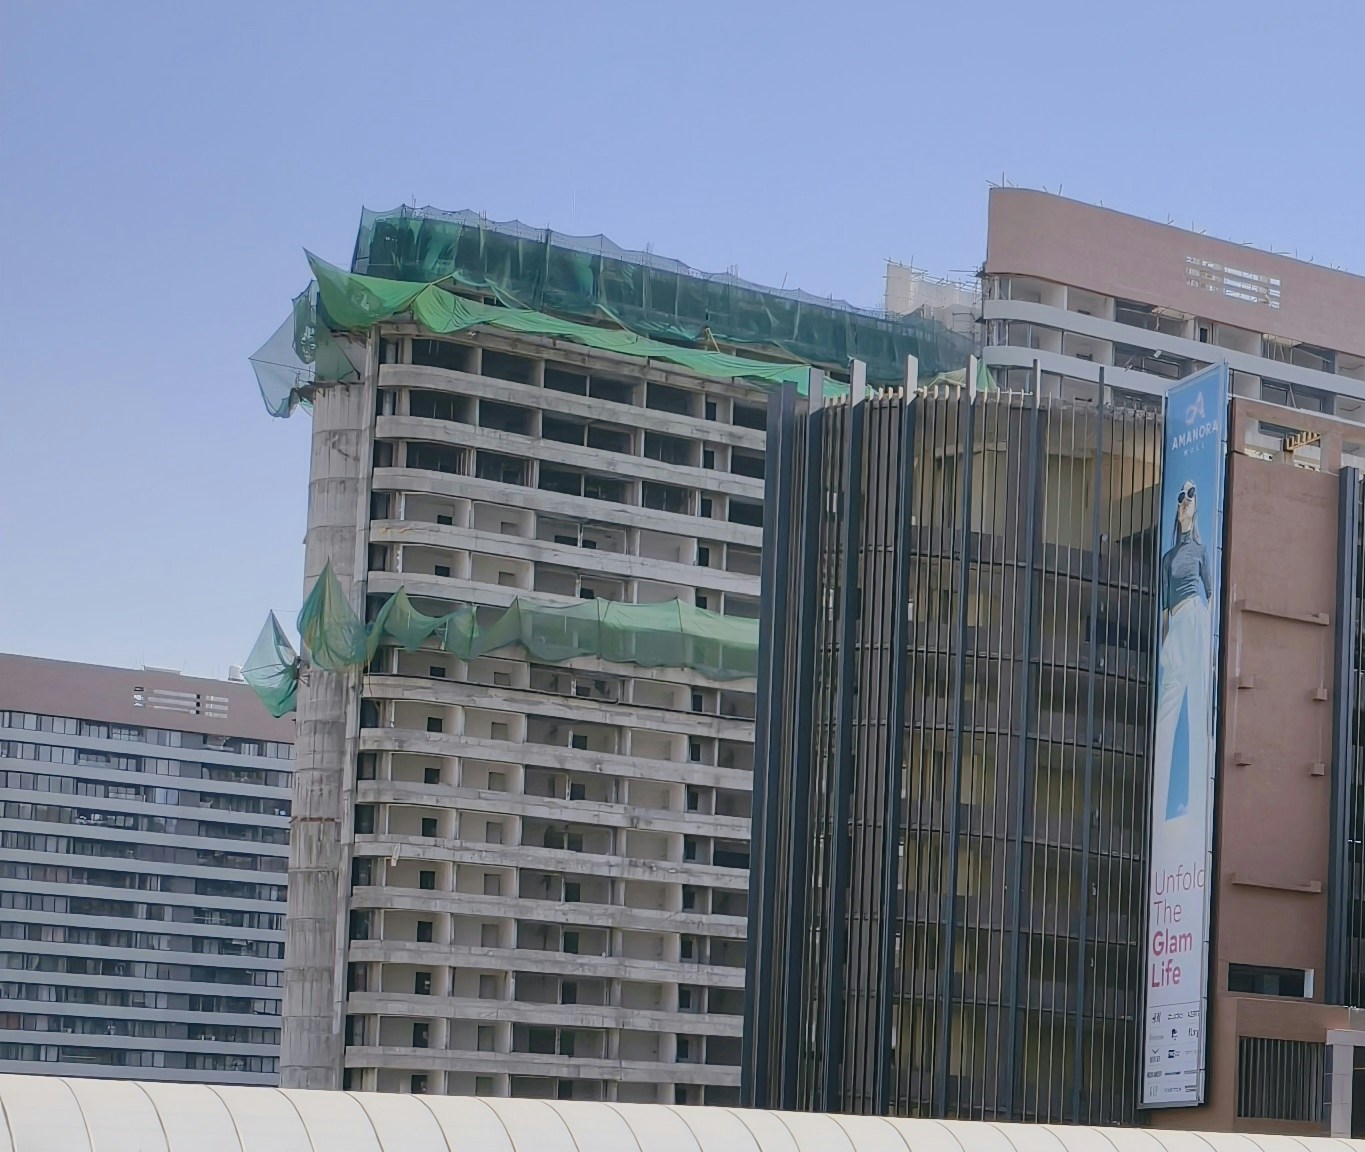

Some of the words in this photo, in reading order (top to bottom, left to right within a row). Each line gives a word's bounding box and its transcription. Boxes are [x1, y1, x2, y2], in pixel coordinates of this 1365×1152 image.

[1171, 420, 1218, 451] AMANORA
[1153, 899, 1182, 926] The
[1152, 928, 1193, 957] Glam
[1151, 959, 1182, 988] Life
